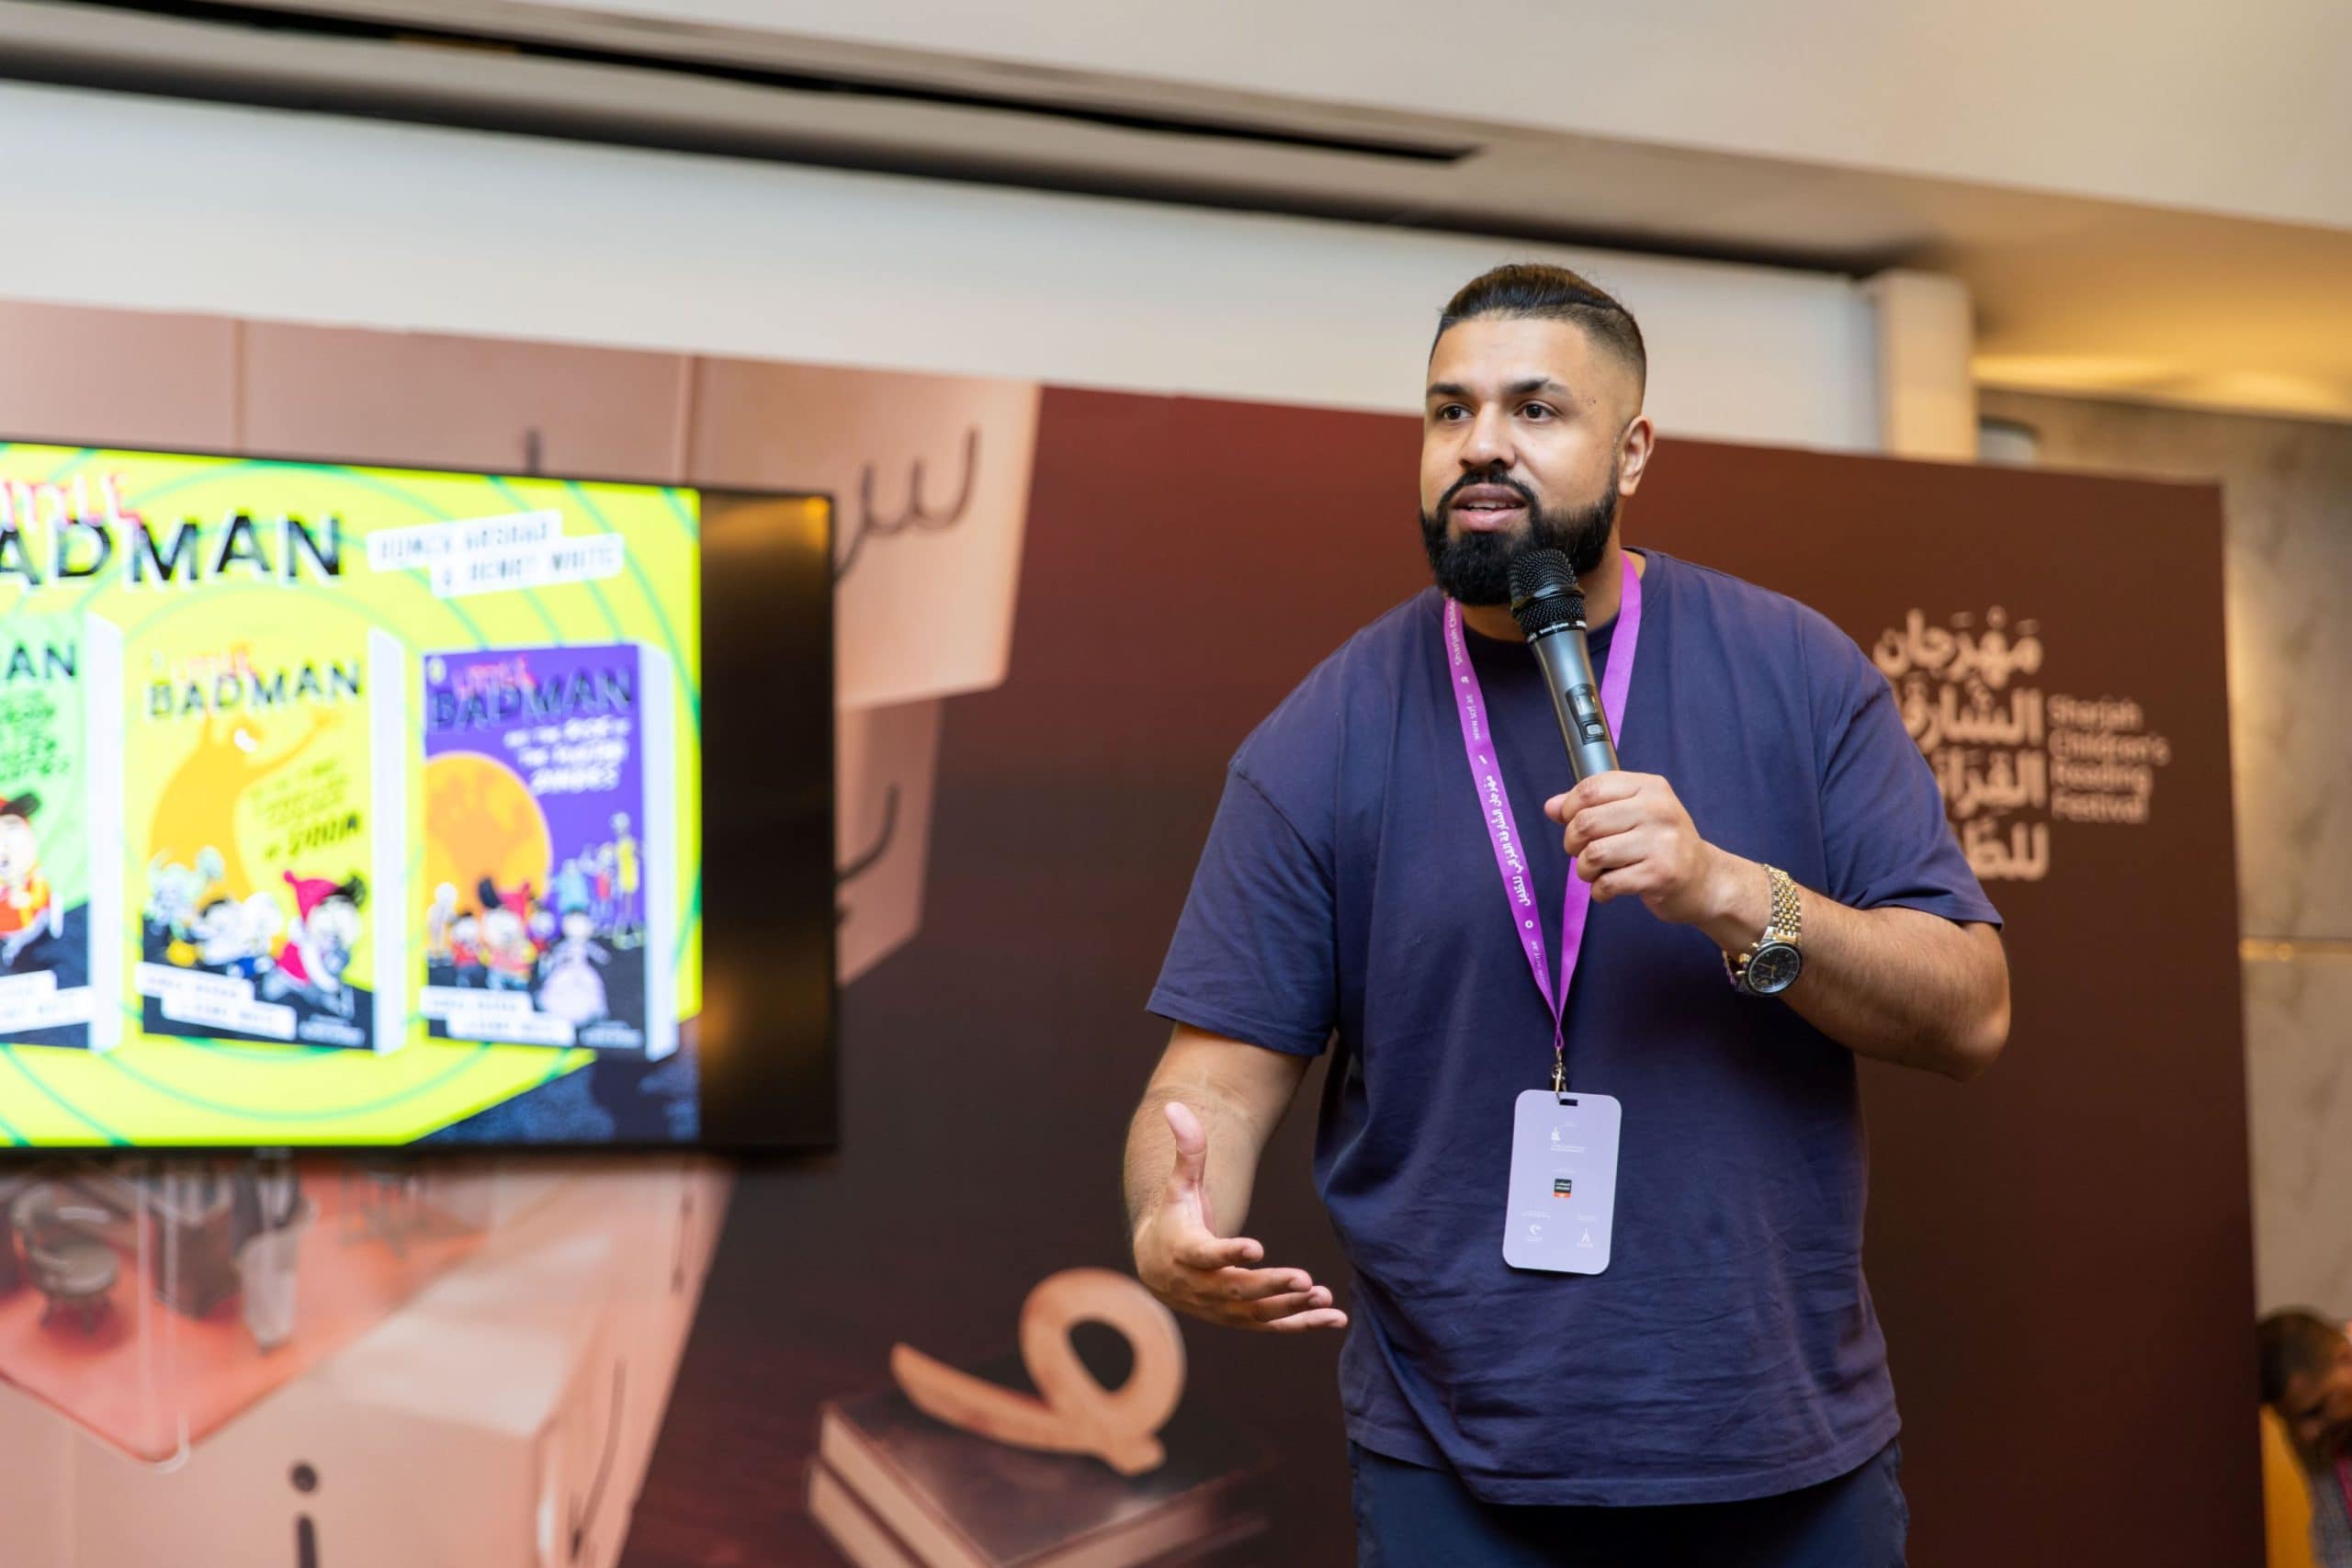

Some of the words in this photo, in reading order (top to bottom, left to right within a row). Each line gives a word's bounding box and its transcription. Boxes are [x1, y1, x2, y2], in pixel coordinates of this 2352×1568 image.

[0, 513, 344, 589] ADMAN
[6, 639, 76, 681] AN
[148, 660, 360, 718] BADMAN
[432, 666, 632, 728] BADMAN
